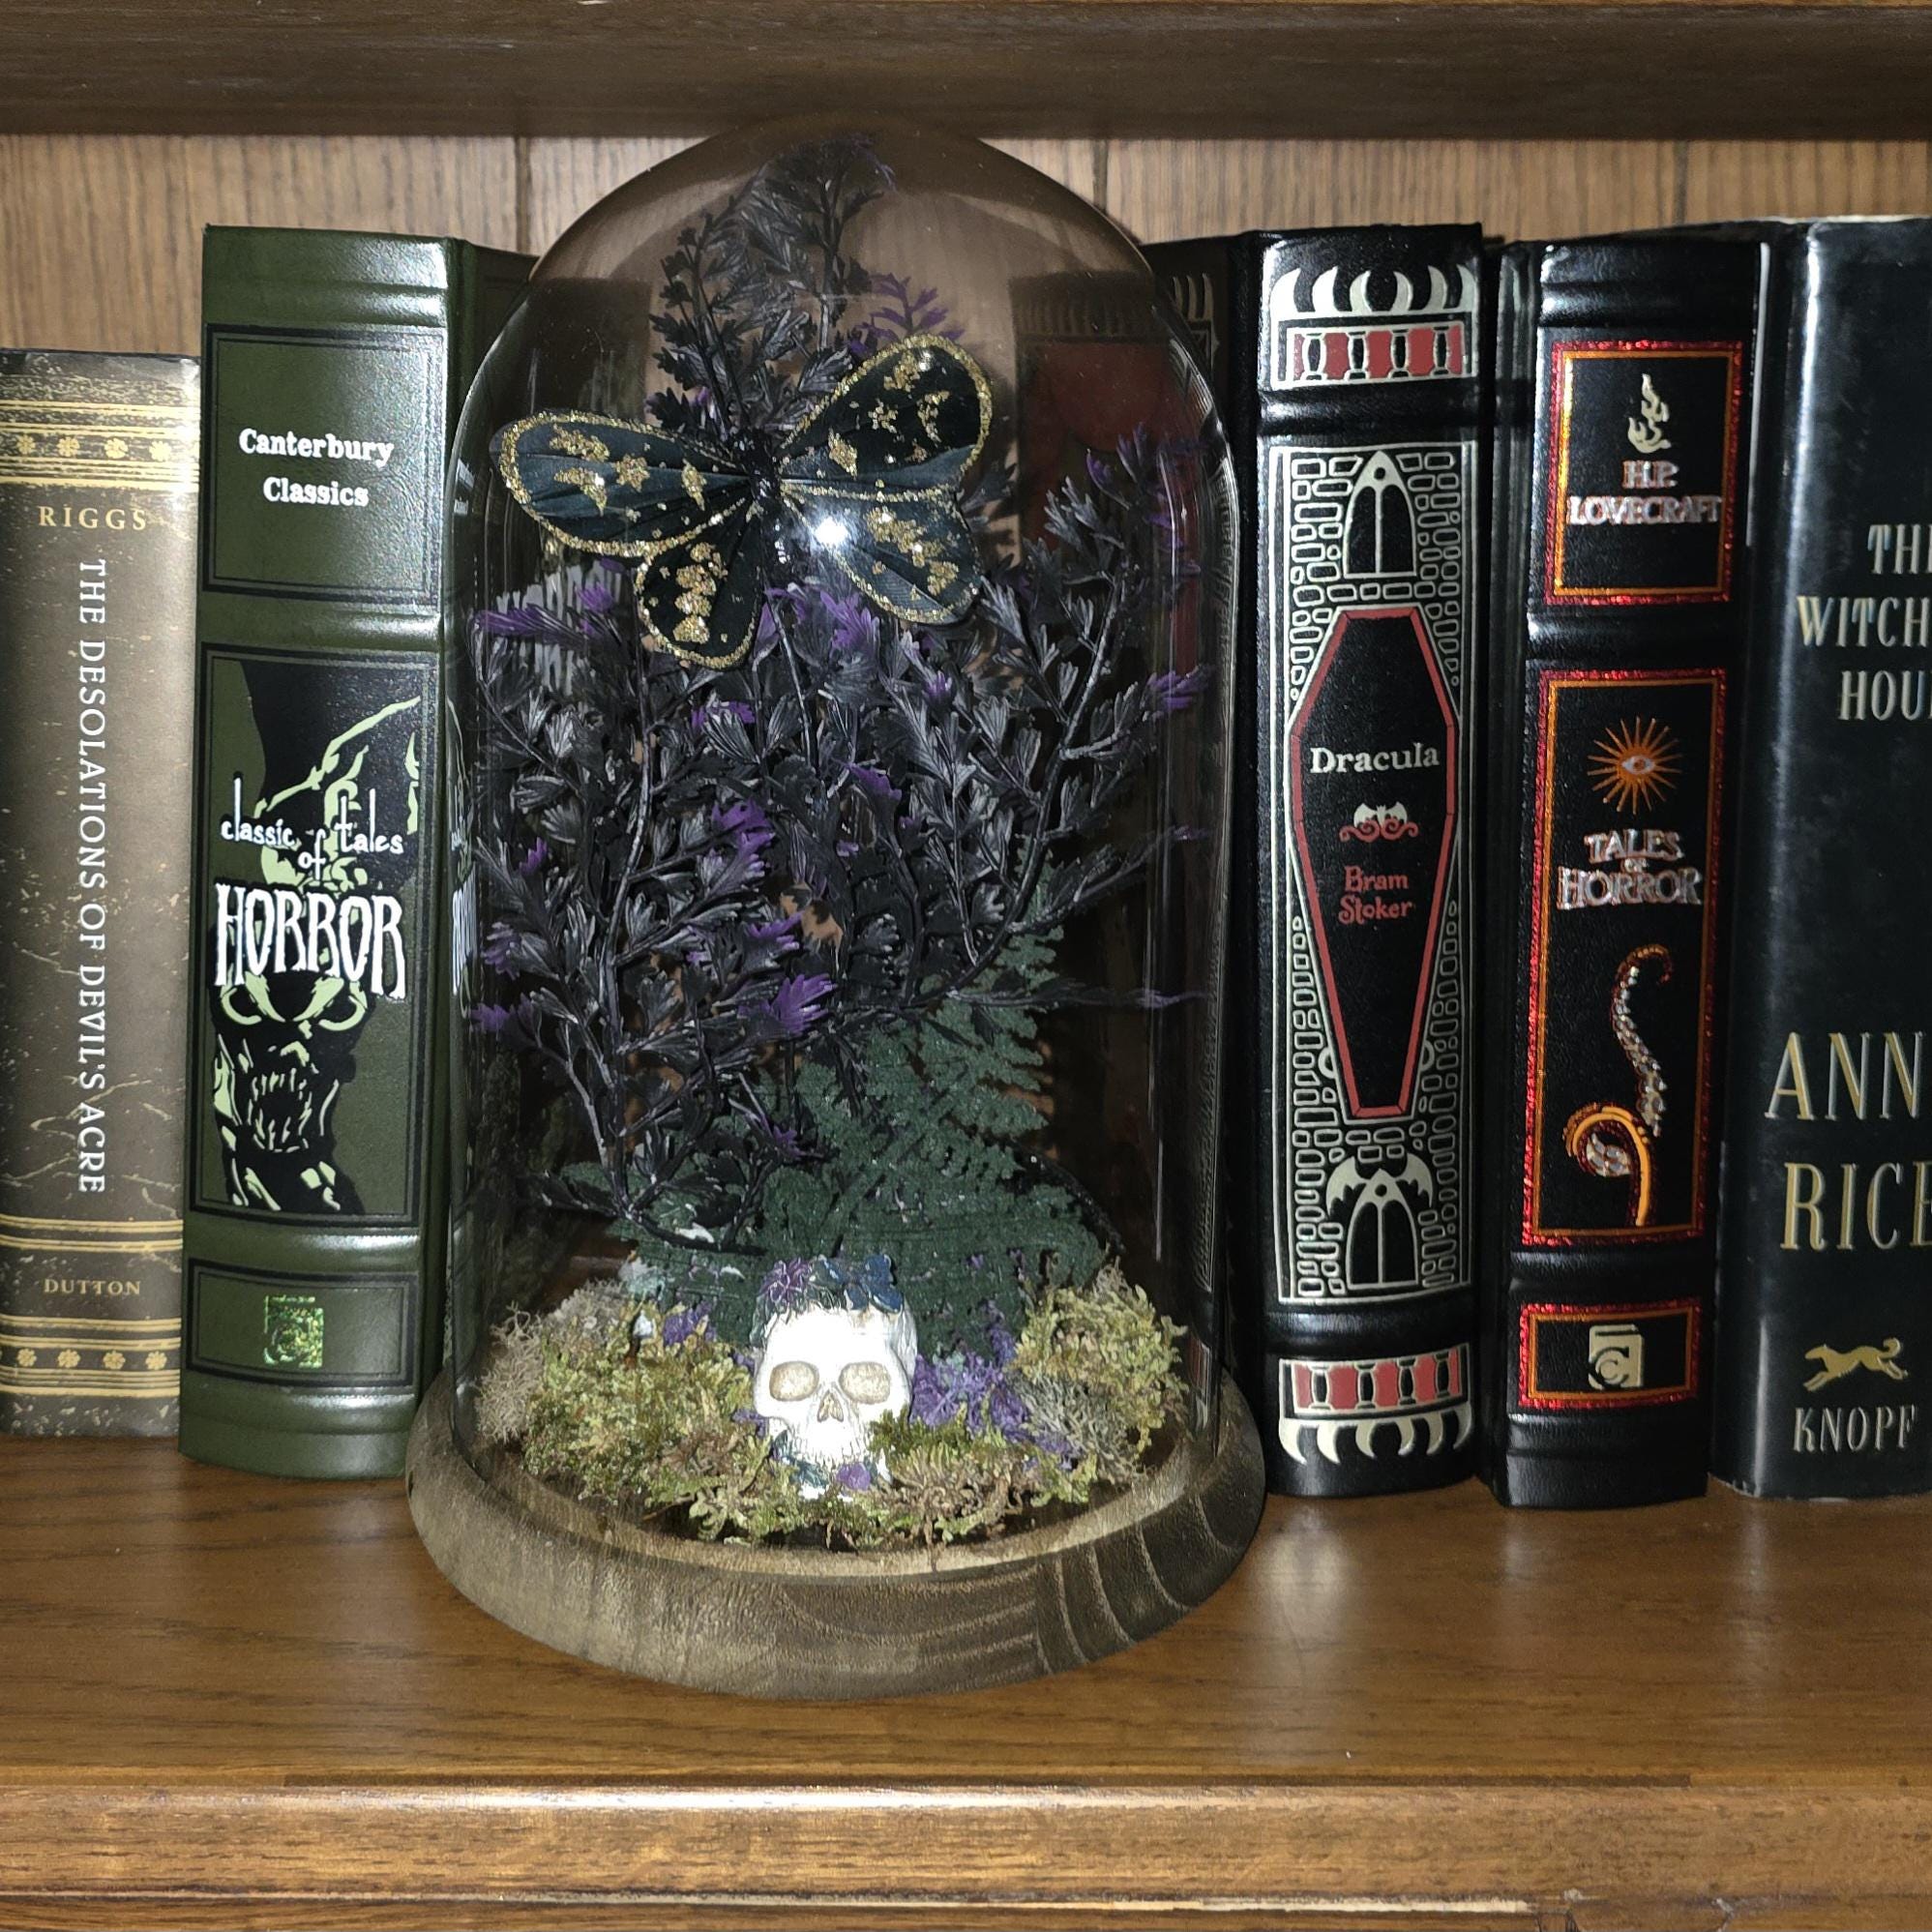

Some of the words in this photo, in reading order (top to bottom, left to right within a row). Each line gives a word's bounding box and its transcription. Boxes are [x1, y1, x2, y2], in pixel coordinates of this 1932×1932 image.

[239, 428, 395, 469] Canterbury
[263, 476, 370, 507] Classics
[1566, 494, 1723, 526] LOVECRAFT
[38, 505, 147, 531] RIGGS
[1867, 523, 1932, 574] TH
[79, 558, 106, 624] THE
[1797, 596, 1931, 647] WITCH
[1839, 669, 1932, 722] HOU
[78, 639, 106, 889] DESOLATIONS
[1309, 742, 1441, 774] Dracula
[221, 777, 296, 847] classic
[334, 788, 404, 855] tales
[297, 828, 327, 880] of
[1584, 827, 1685, 864] TALES
[1344, 866, 1410, 893] Bram
[1556, 866, 1704, 910] HORROR
[78, 903, 106, 951] OF
[1338, 896, 1415, 925] Stoker
[214, 882, 406, 999] HORROR
[78, 966, 106, 1090] DEVIL'S
[1764, 1031, 1925, 1120] ANN
[78, 1102, 106, 1193] ACRE
[44, 1278, 141, 1295] DUTTON
[1794, 1404, 1916, 1452] KNOPF
